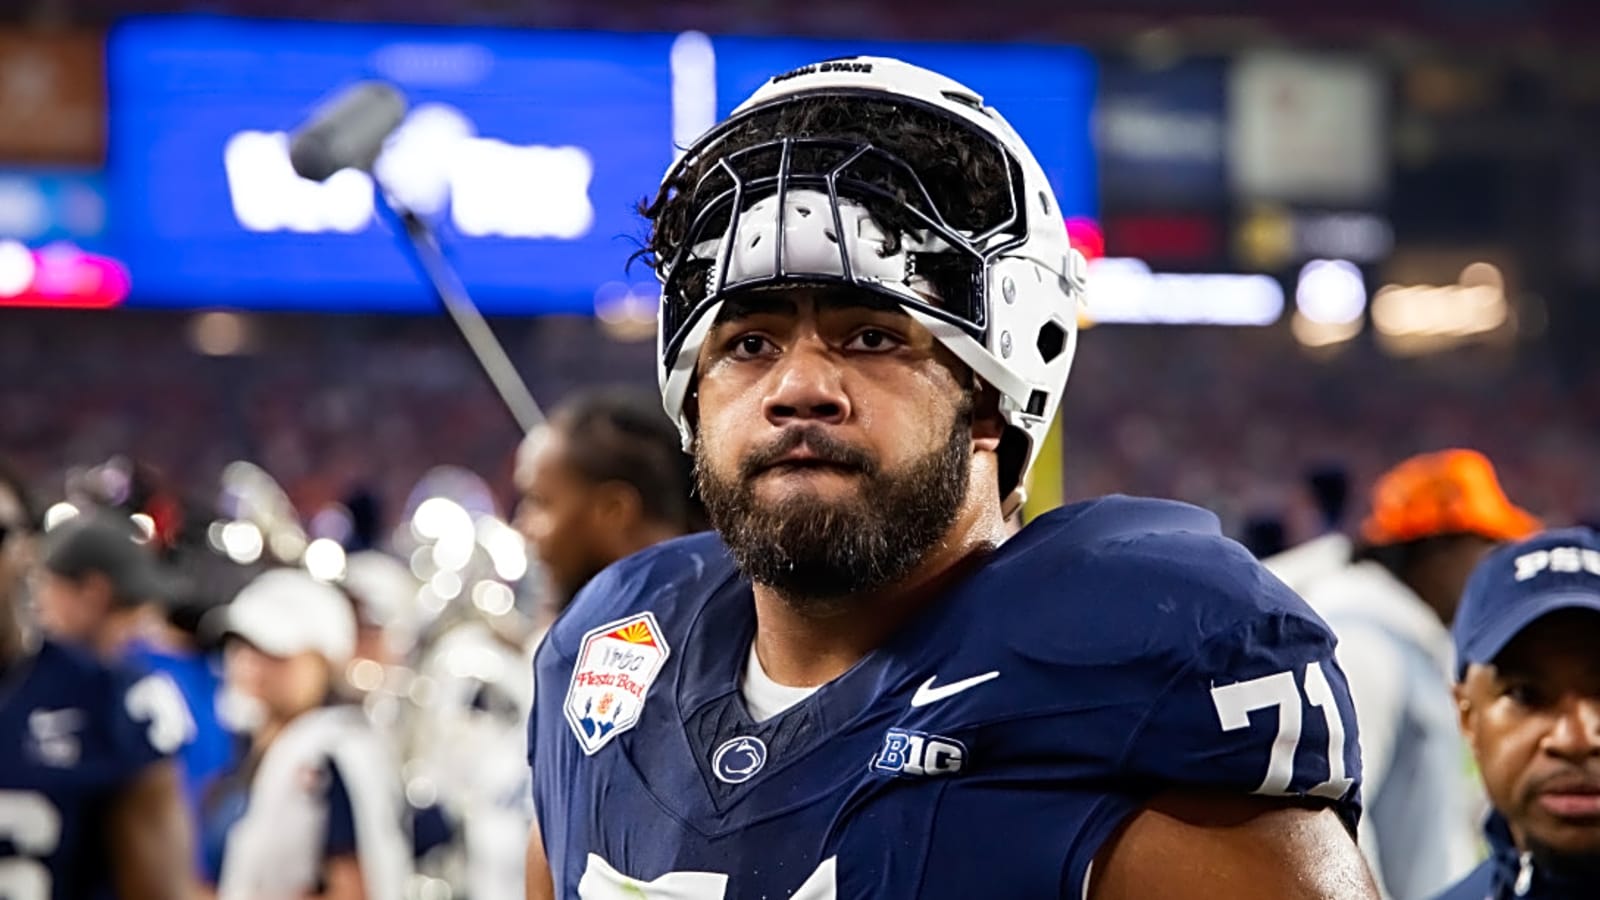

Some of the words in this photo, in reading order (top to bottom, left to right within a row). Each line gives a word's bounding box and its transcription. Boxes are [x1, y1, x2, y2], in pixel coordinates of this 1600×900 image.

[820, 63, 872, 73] STATE
[576, 671, 616, 688] Fiesta
[616, 673, 645, 698] Bowl
[1210, 662, 1355, 800] 71
